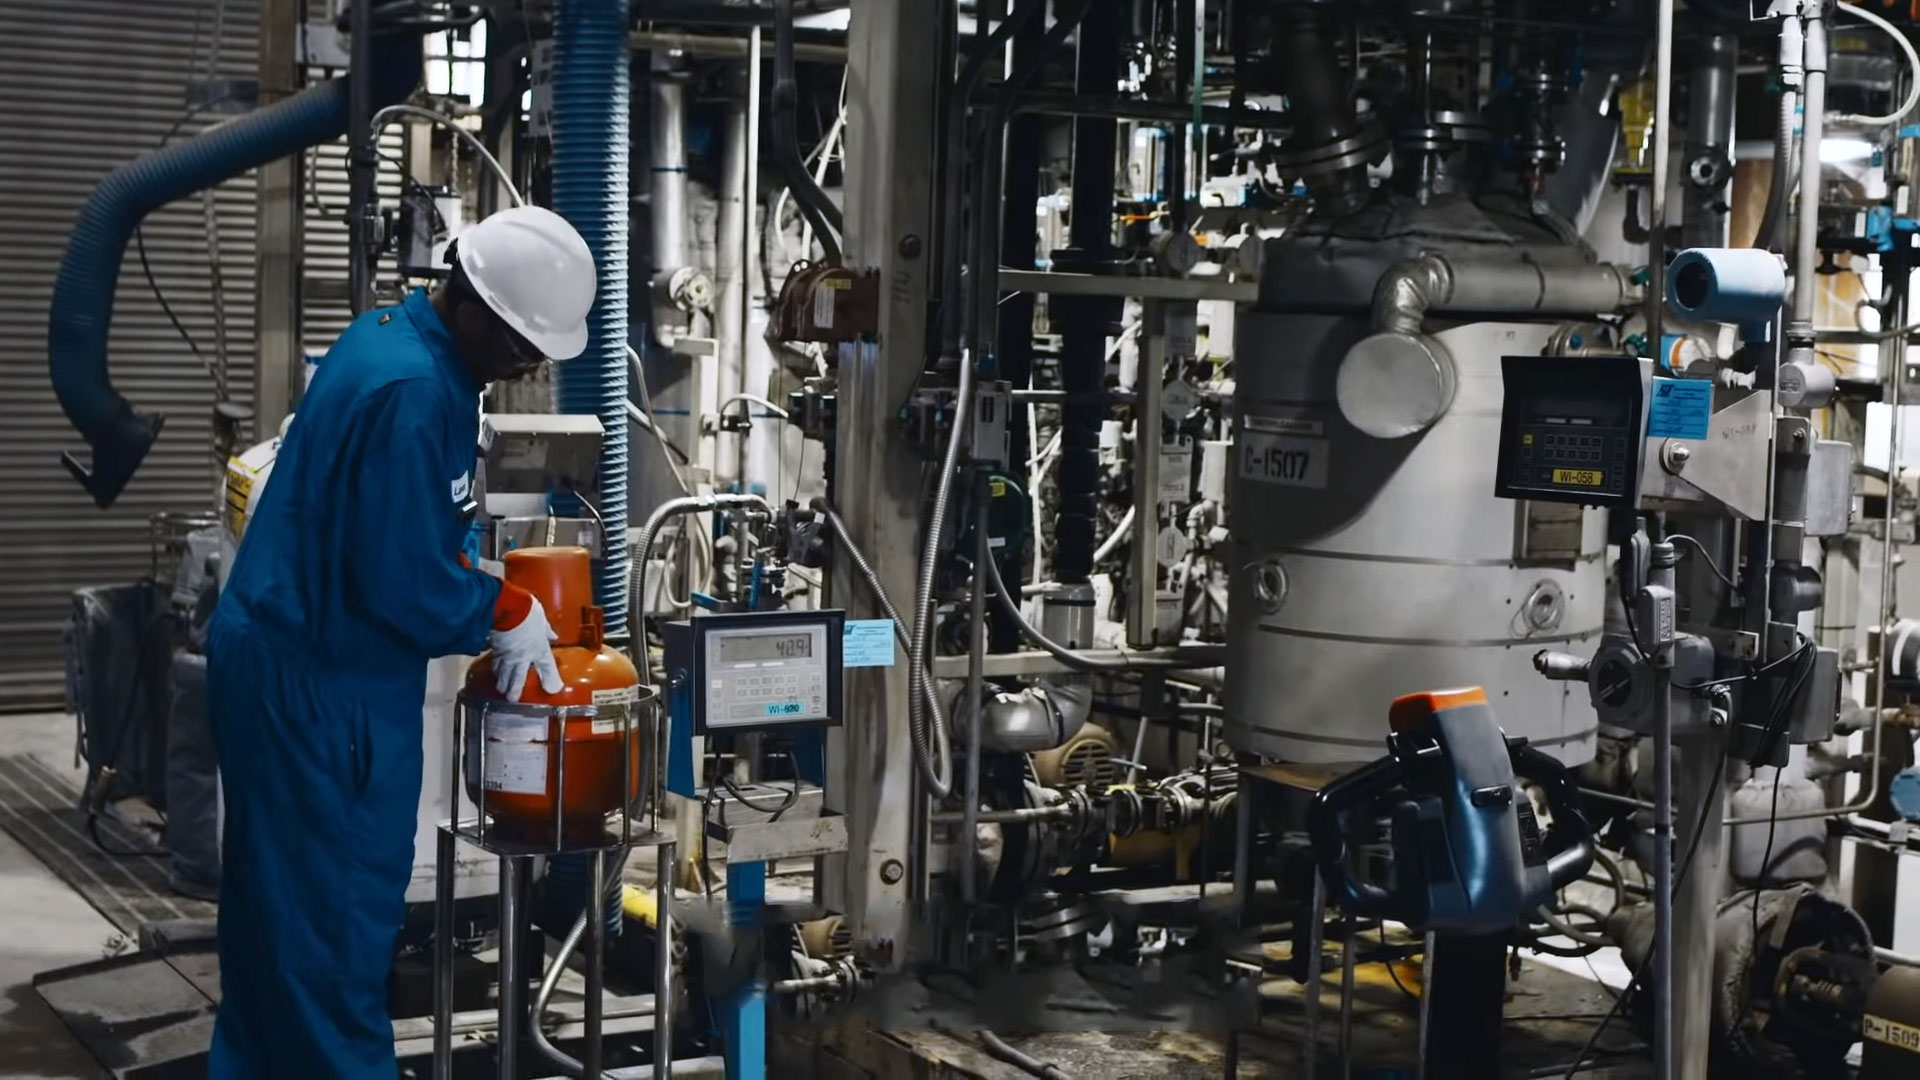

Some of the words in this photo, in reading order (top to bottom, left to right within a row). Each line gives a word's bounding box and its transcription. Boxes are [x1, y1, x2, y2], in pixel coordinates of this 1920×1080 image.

[1244, 446, 1309, 480] C-1507
[1560, 470, 1594, 484] WI-058
[1865, 1019, 1919, 1048] P-1509
